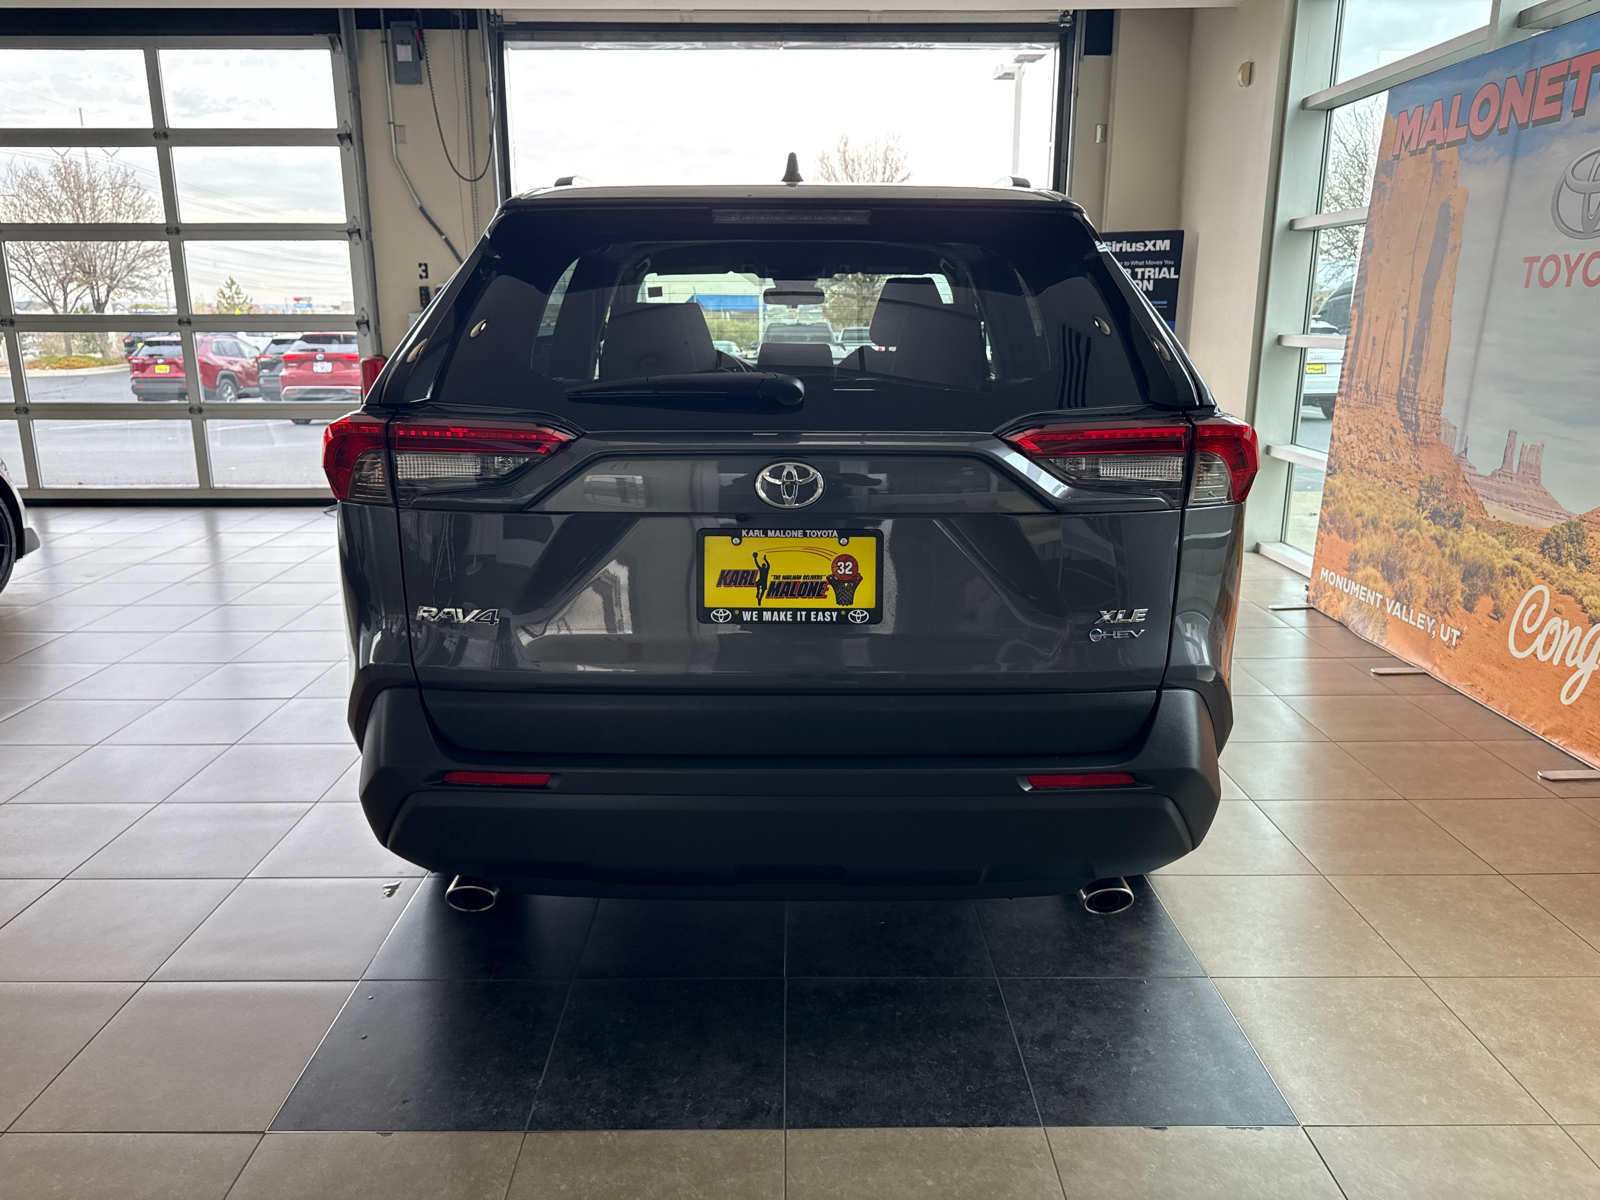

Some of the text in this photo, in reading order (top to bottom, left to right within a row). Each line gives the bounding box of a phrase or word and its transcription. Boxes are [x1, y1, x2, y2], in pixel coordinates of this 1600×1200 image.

[1392, 48, 1600, 160] MALONET
[1104, 239, 1171, 252] SiriusXM
[418, 262, 429, 279] 3
[1135, 267, 1179, 279] TRIAL
[741, 529, 839, 538] KARL MALONE TOYOTA
[837, 561, 853, 575] 32
[716, 569, 758, 587] KARL
[765, 580, 829, 599] MALONE
[416, 605, 500, 625] RAV4
[1320, 567, 1461, 647] MONUMENT VALLEY, UT
[742, 611, 838, 622] WE MAKE IT EASY
[1093, 608, 1149, 625] XLE
[1508, 584, 1600, 705] Cong
